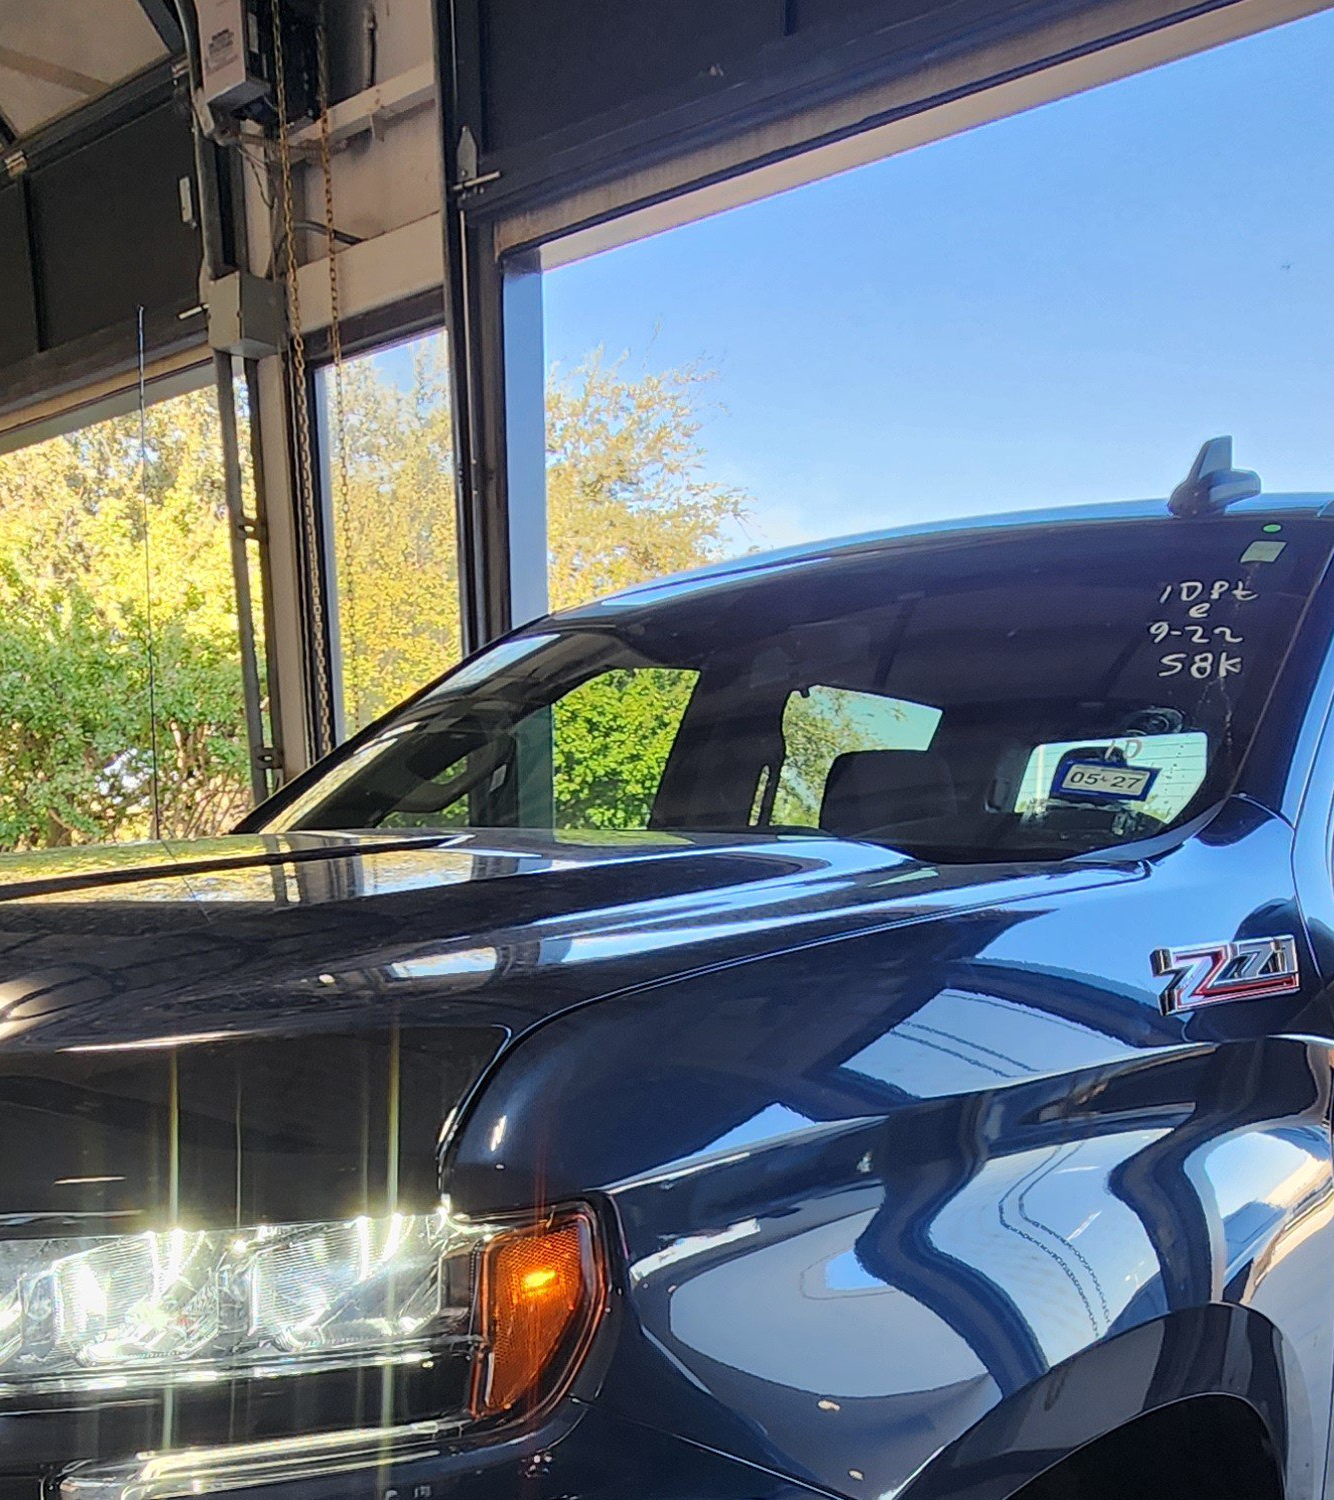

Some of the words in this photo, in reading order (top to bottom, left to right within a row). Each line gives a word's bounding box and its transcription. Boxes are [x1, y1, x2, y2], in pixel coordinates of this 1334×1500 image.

[1149, 621, 1244, 644] 9-22
[1110, 775, 1144, 789] 27
[1149, 934, 1301, 1016] Z71
